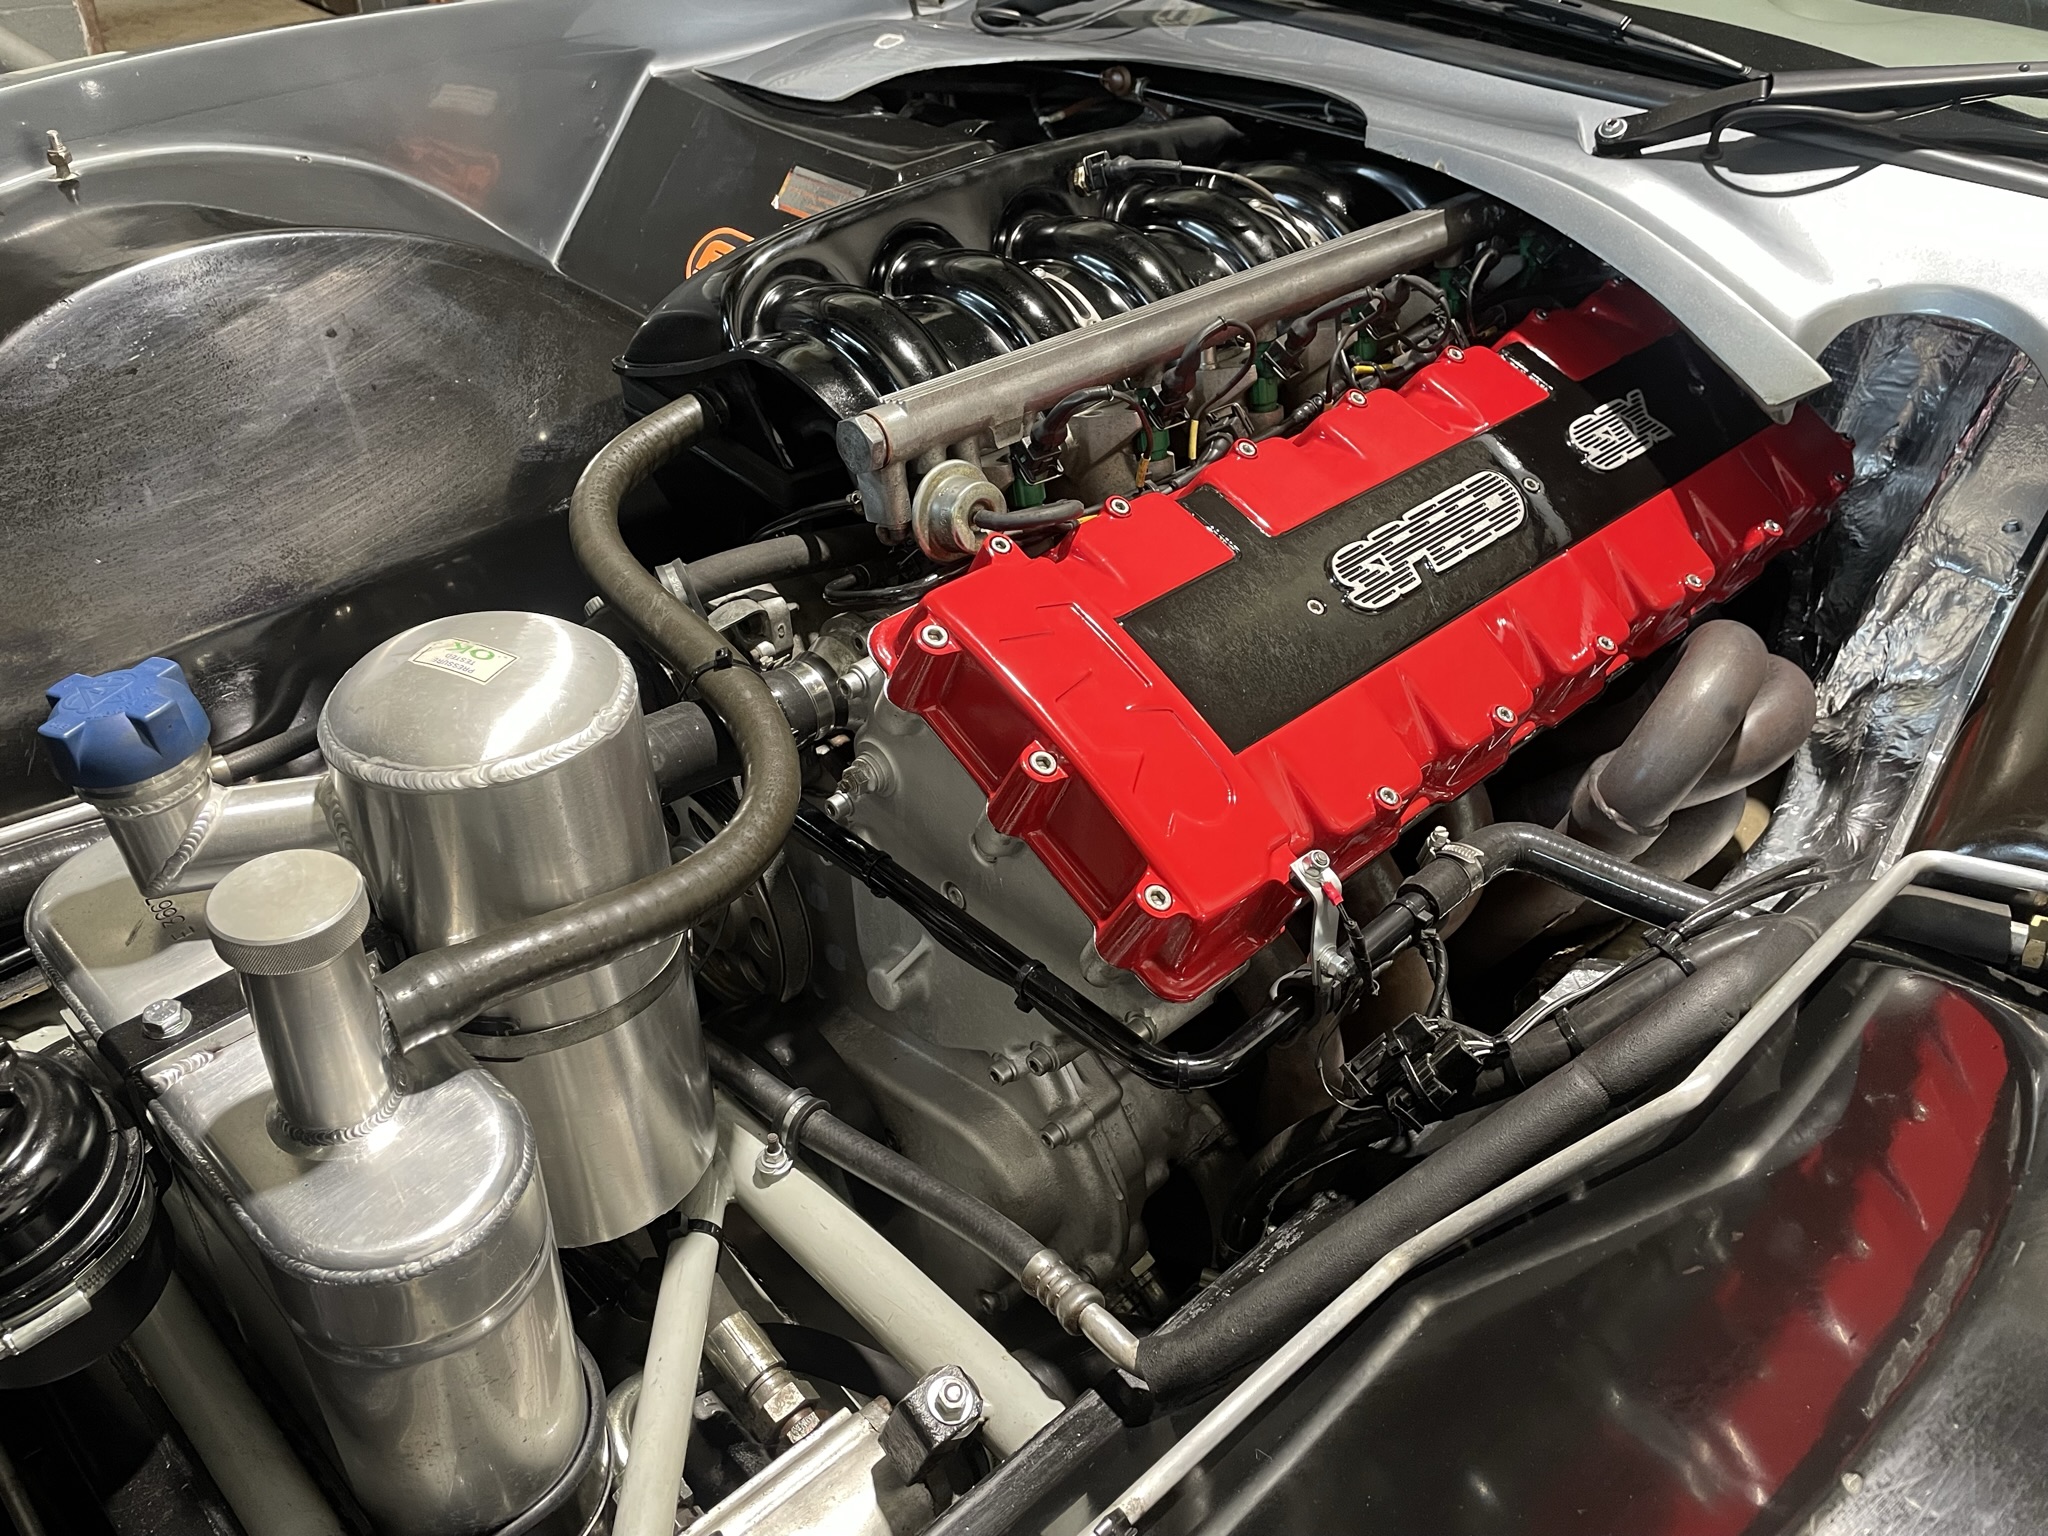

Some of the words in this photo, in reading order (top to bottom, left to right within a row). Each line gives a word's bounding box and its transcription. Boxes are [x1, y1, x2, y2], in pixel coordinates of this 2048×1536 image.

[1331, 470, 1526, 610] SPEED
[1569, 388, 1674, 472] SIX
[447, 642, 494, 660] OK
[433, 658, 475, 673] PRESSURE
[447, 654, 475, 665] TESTED
